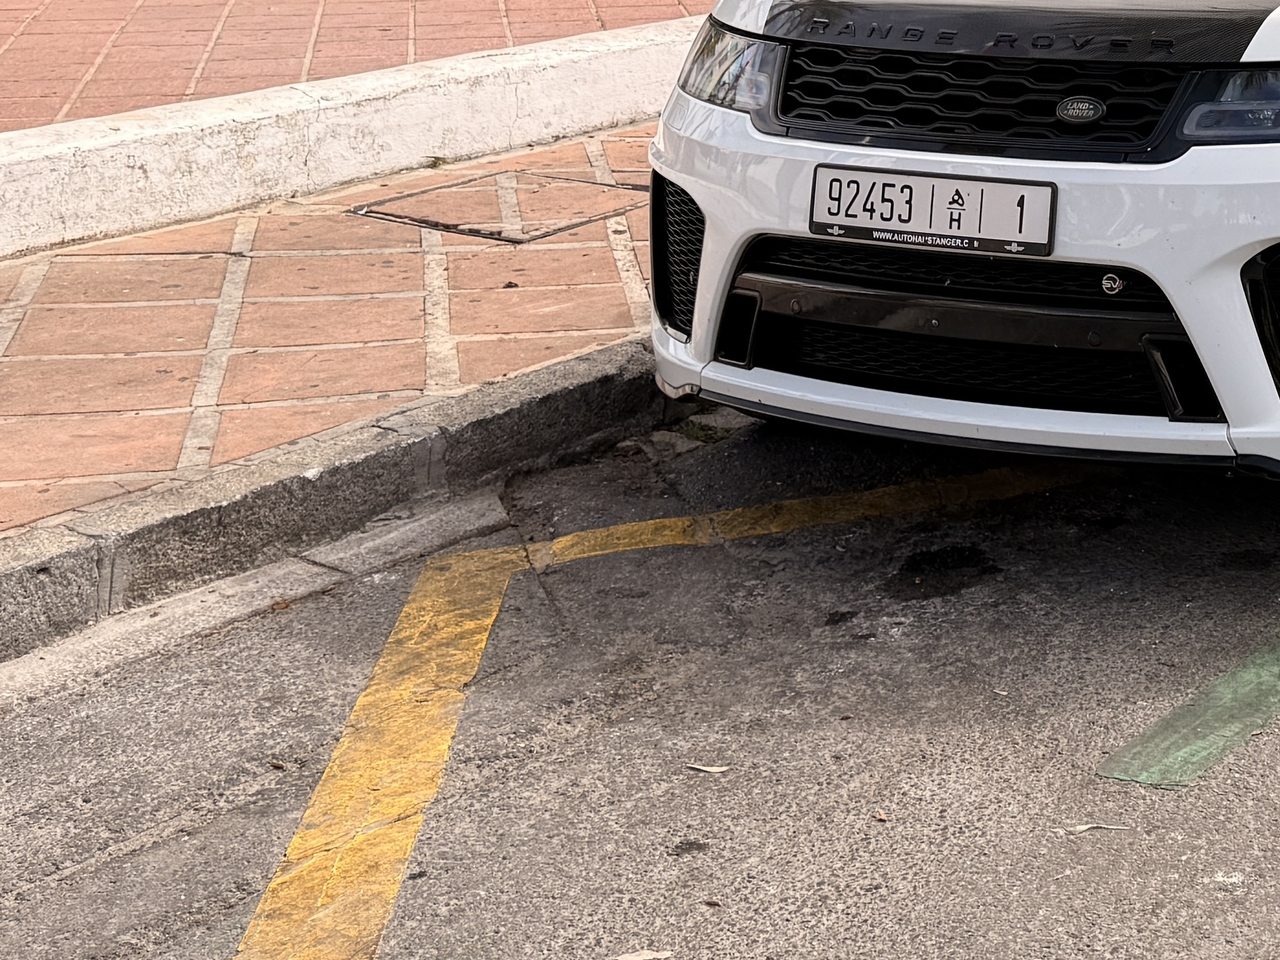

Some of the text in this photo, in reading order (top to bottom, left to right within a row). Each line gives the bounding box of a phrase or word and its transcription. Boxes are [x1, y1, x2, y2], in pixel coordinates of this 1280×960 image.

[807, 17, 1175, 54] RANGE ROVER
[827, 177, 913, 224] 92453
[1016, 194, 1026, 234] 1
[949, 211, 961, 230] H
